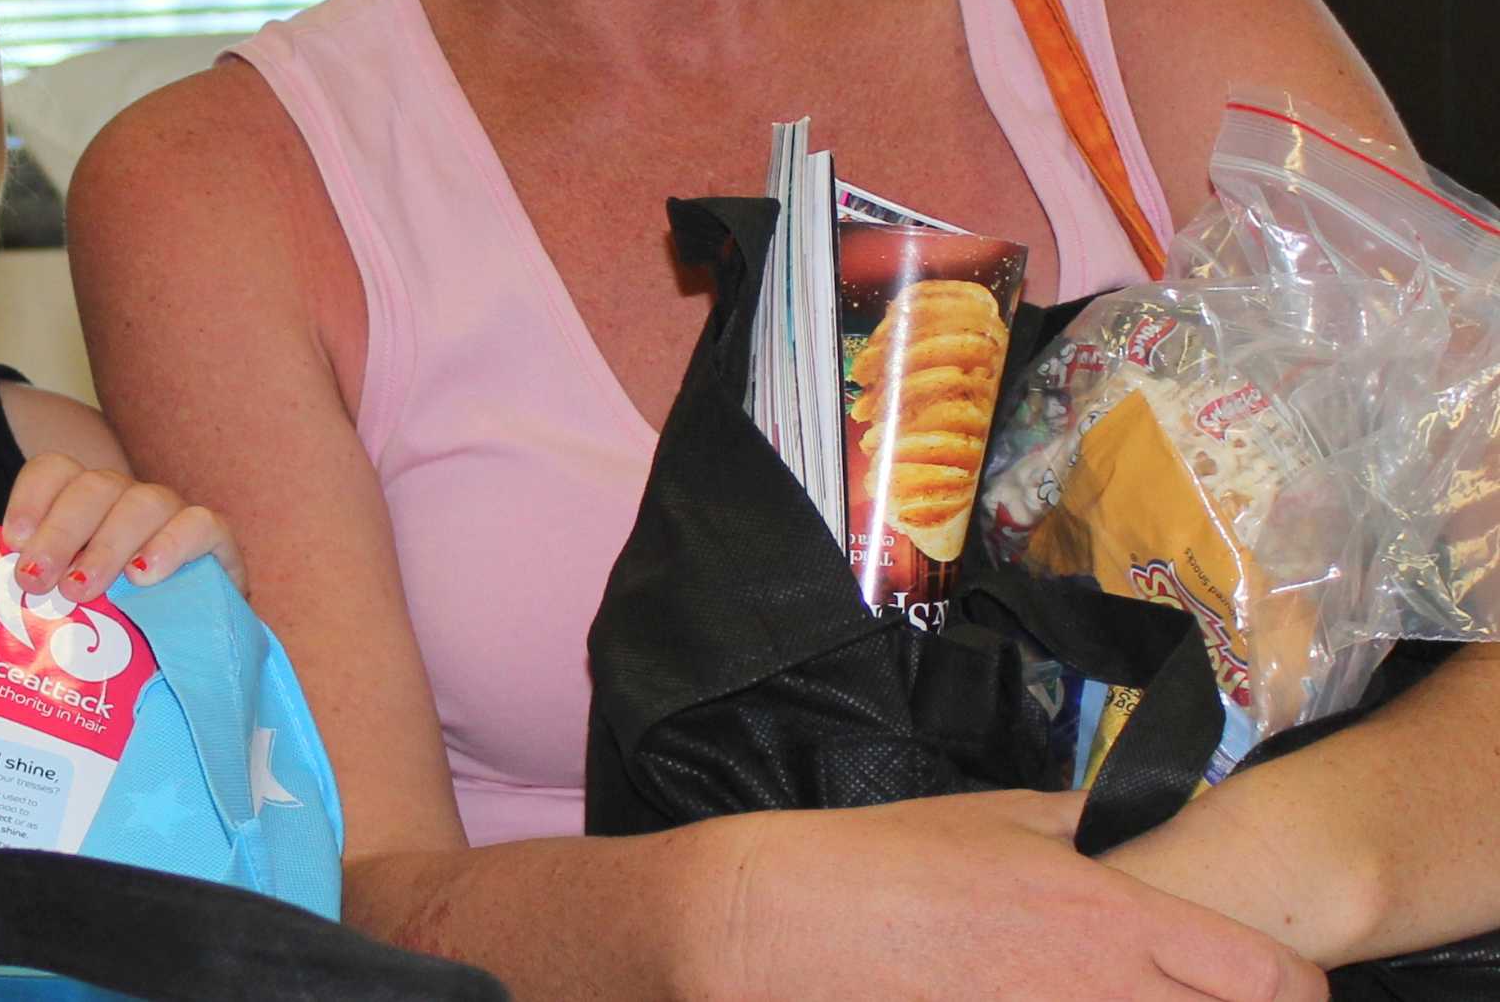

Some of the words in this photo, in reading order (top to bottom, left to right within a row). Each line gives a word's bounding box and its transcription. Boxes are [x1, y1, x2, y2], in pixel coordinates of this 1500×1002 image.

[56, 707, 72, 722] in
[74, 711, 107, 734] hair
[5, 757, 60, 783] shine,
